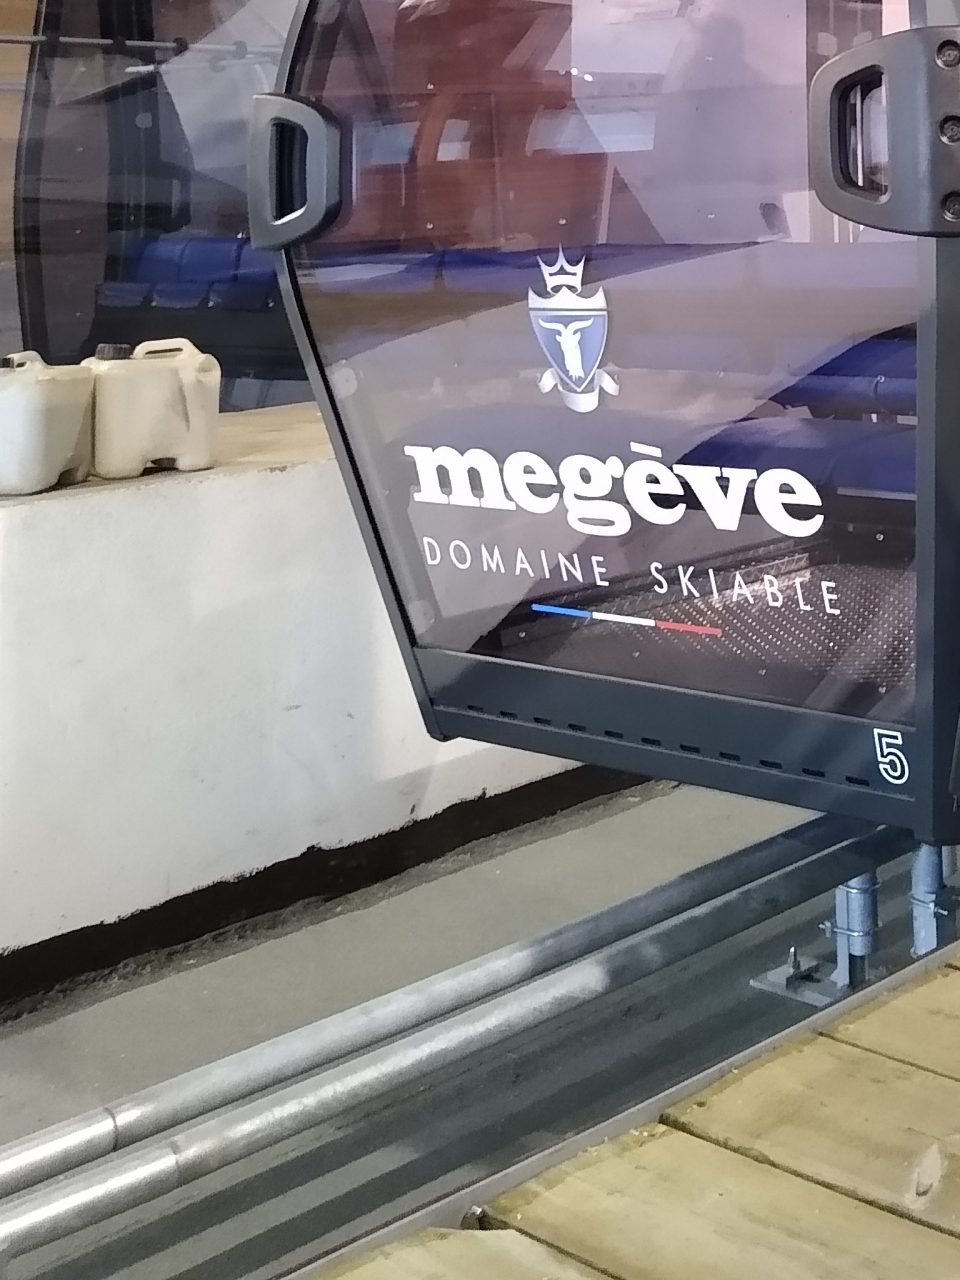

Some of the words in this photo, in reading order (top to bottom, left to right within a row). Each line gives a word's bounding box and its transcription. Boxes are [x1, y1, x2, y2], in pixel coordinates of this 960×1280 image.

[404, 441, 825, 538] megève
[422, 536, 610, 587] DOMAINE
[651, 562, 841, 615] SKIABLE
[873, 728, 909, 784] 5
